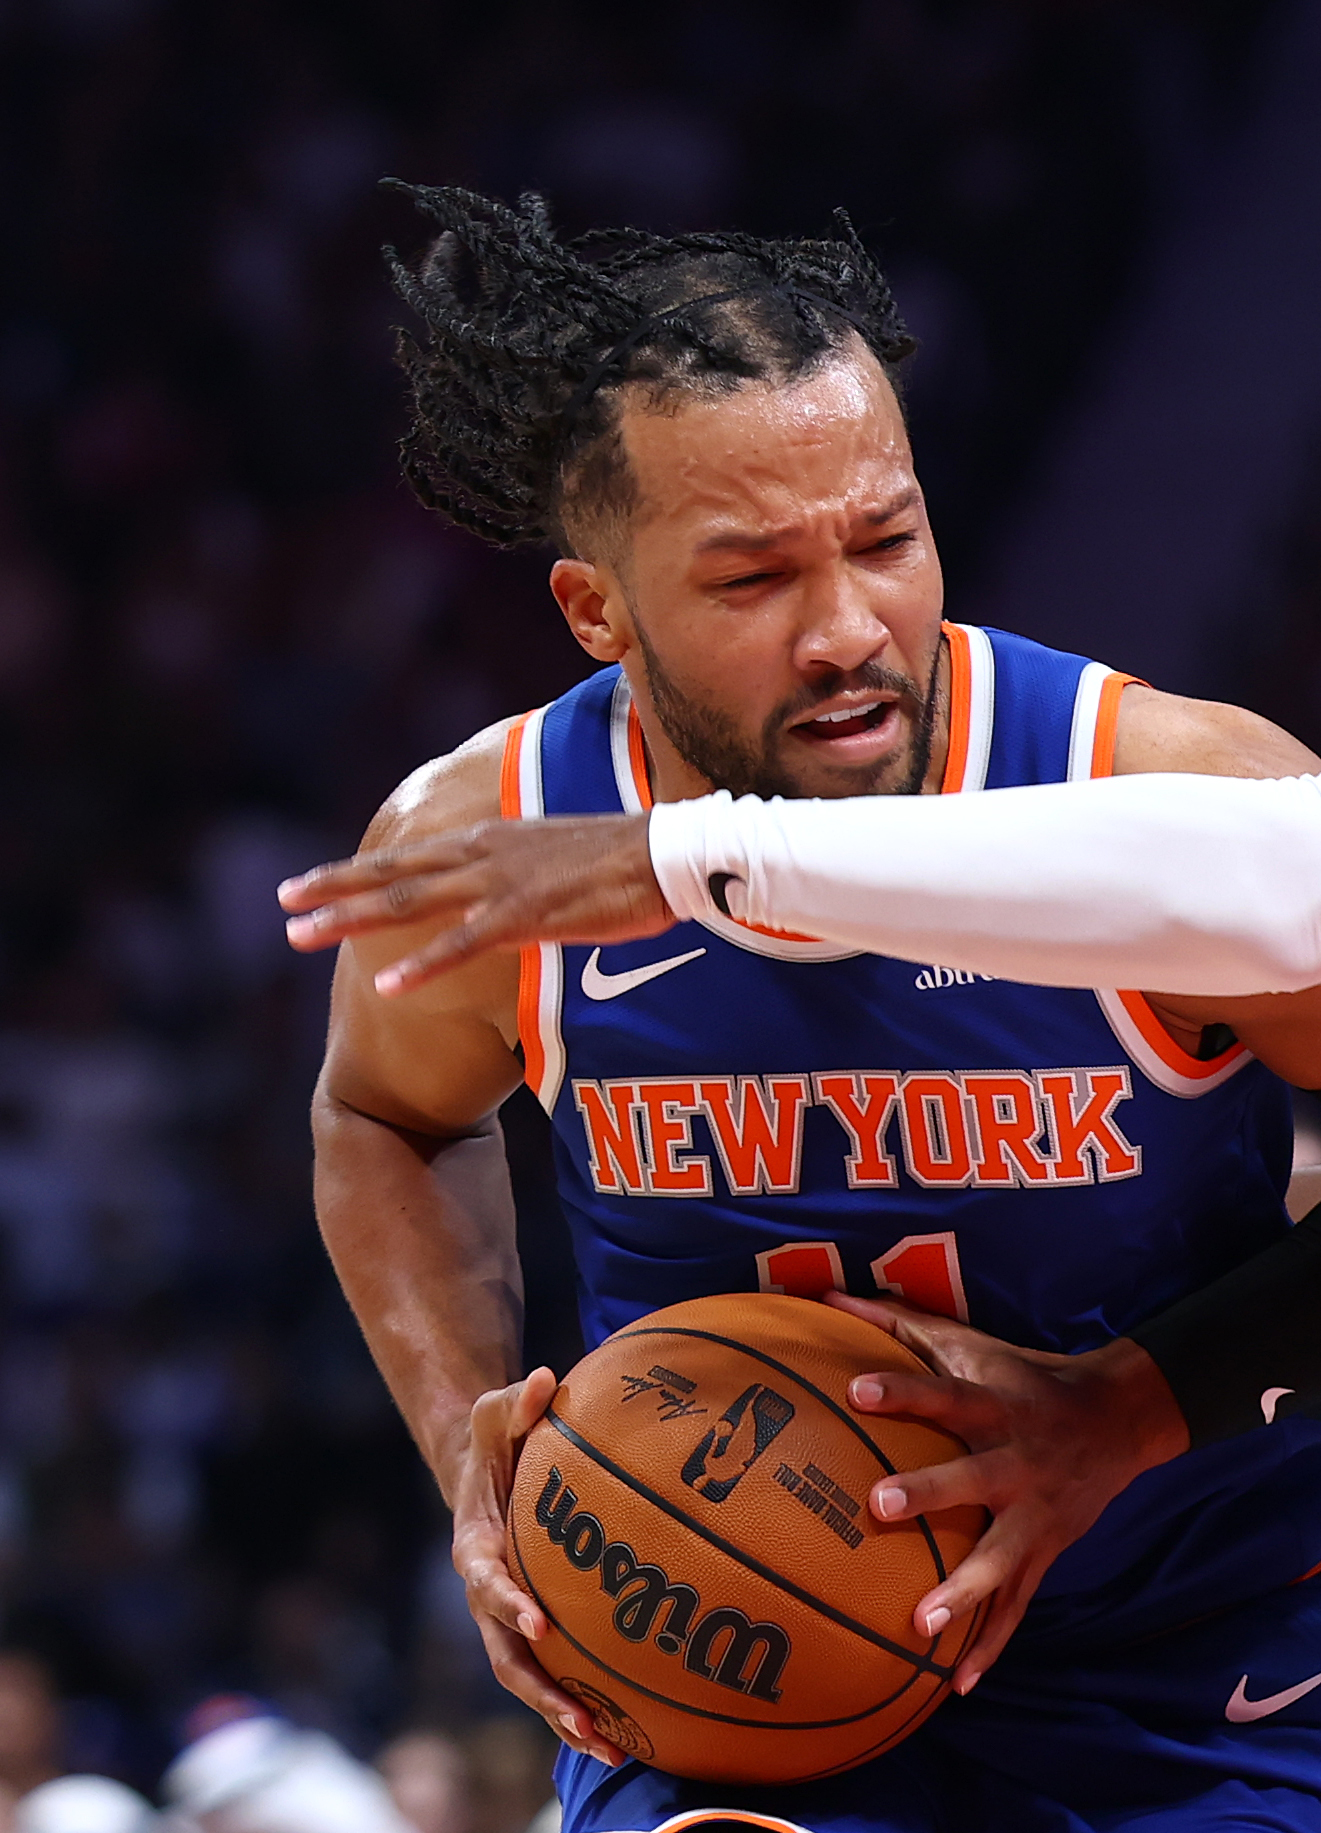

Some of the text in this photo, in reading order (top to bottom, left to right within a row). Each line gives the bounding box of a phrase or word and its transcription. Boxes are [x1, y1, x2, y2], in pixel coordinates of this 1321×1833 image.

[571, 1066, 1143, 1197] NEW YORK
[535, 1466, 792, 1704] Wilson
